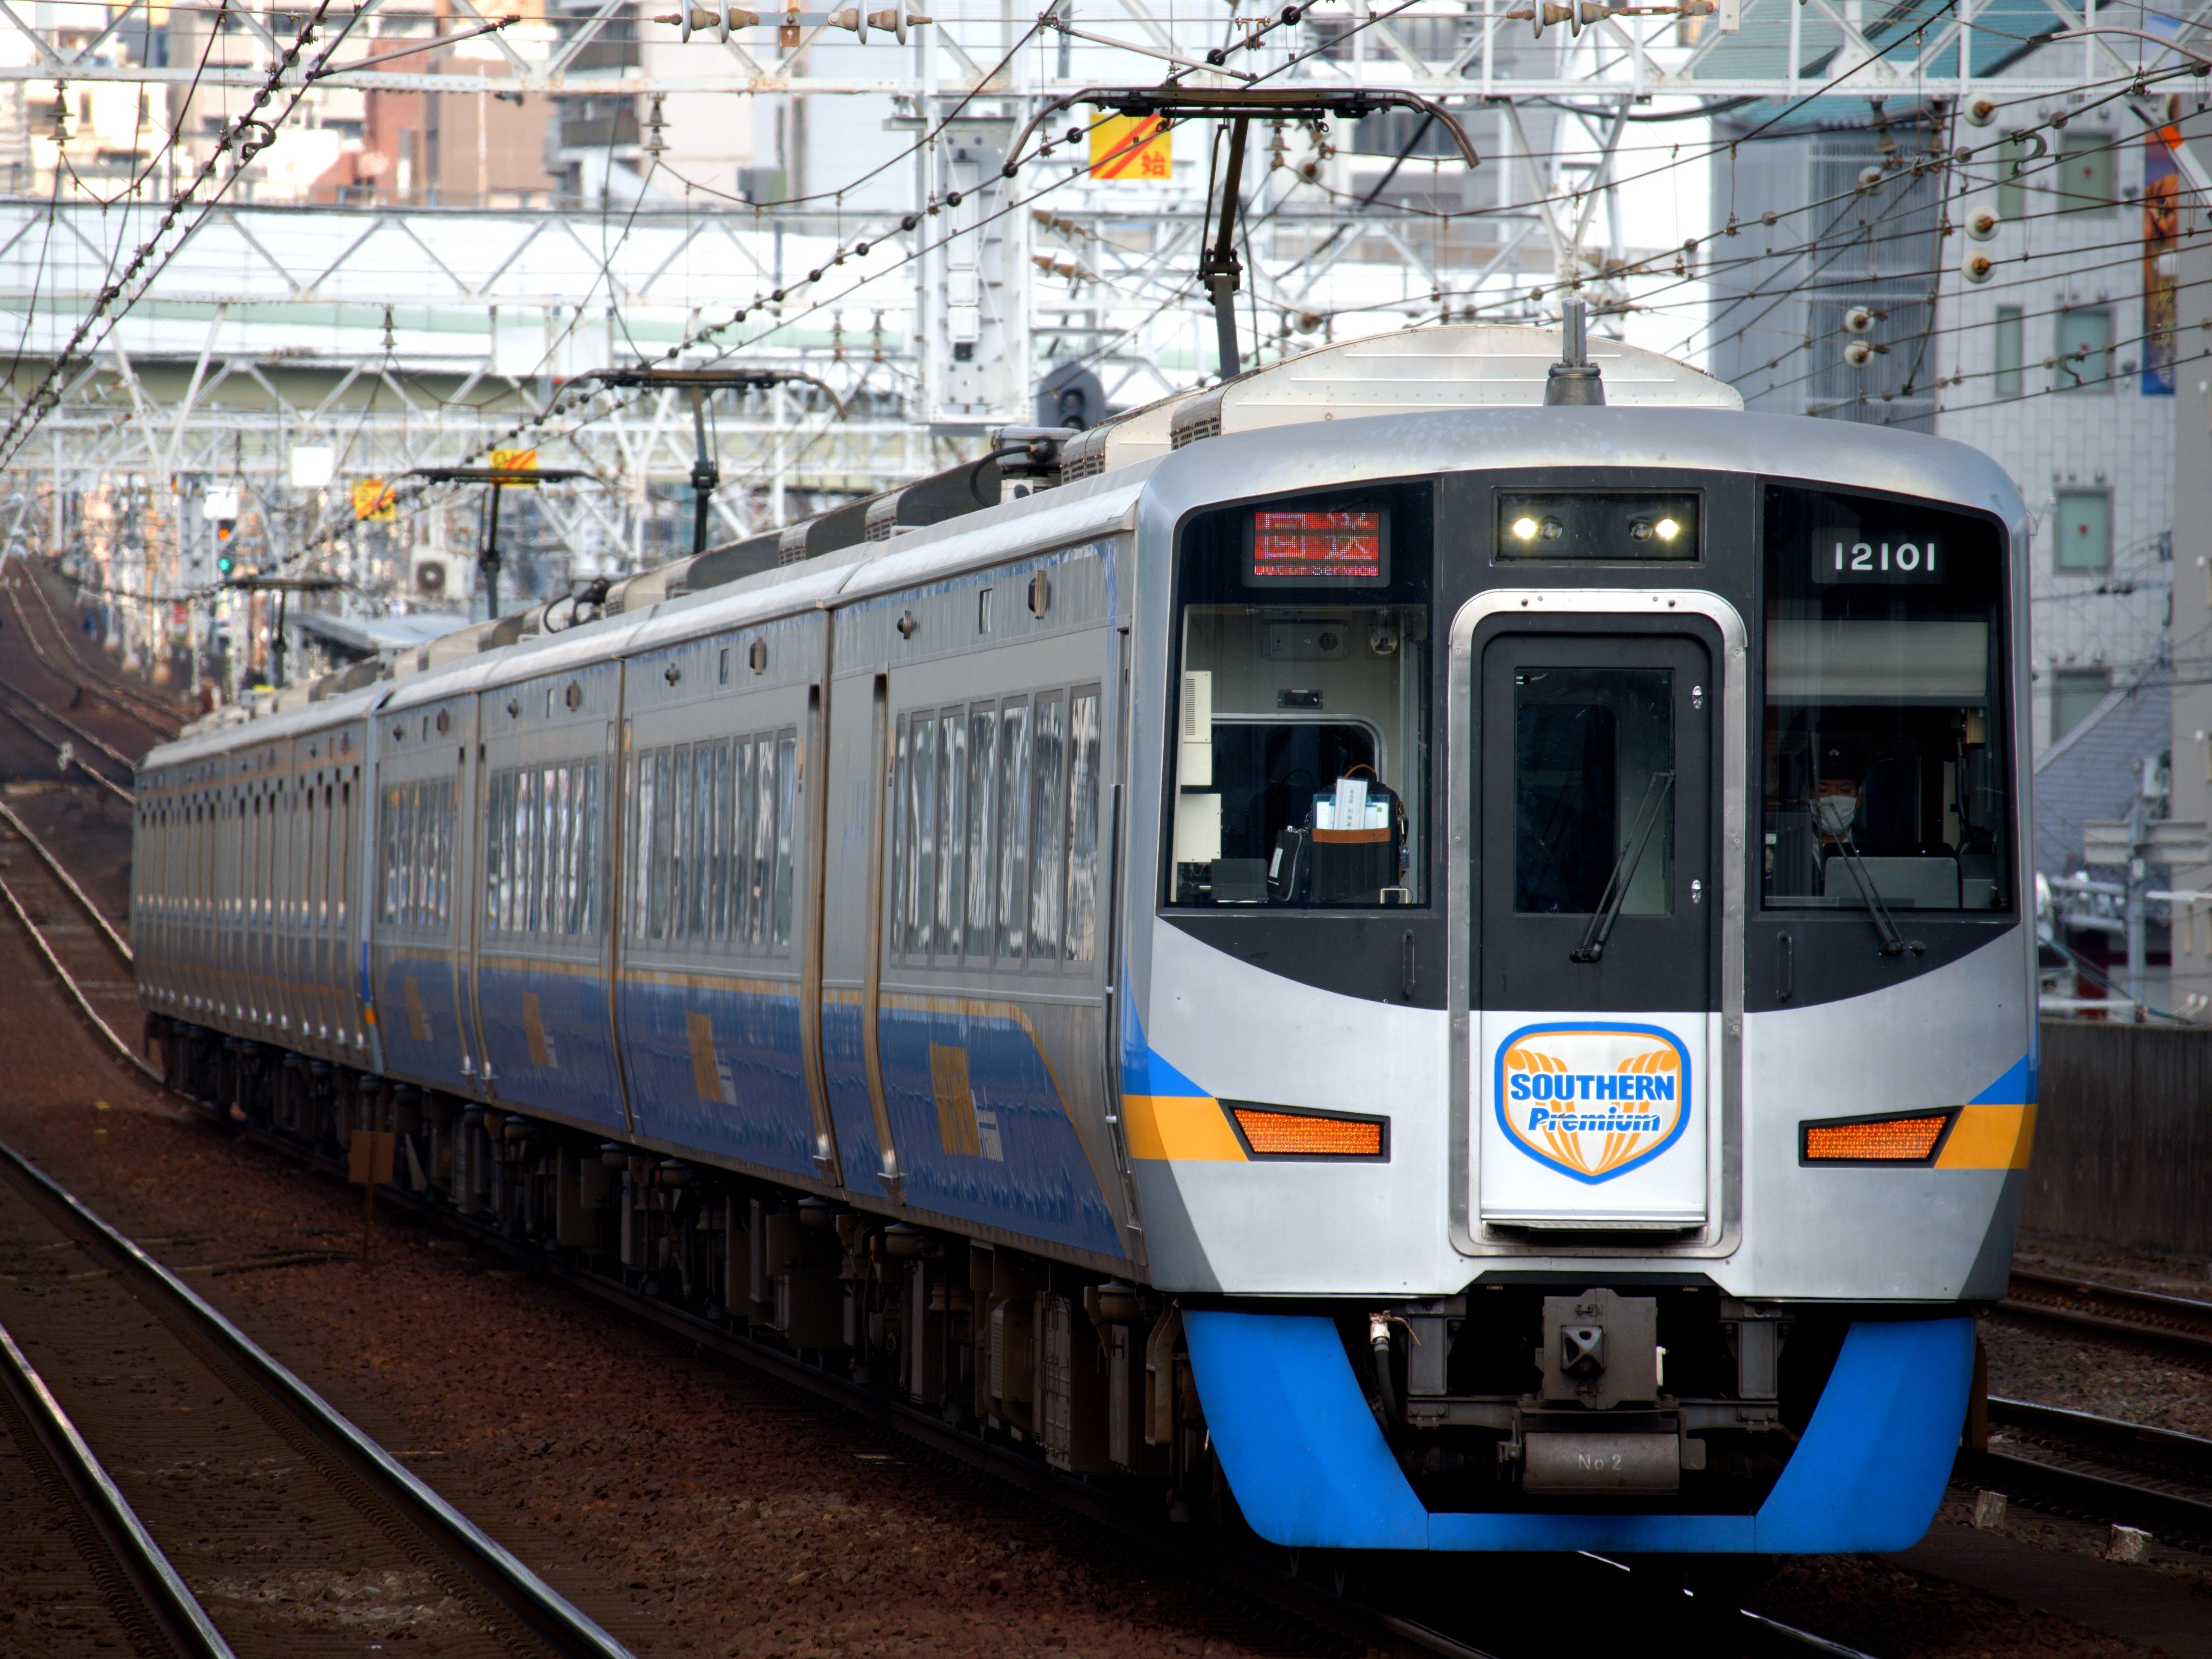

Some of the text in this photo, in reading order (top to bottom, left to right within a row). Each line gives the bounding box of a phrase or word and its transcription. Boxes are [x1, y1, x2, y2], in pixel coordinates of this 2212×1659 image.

[1141, 151, 1166, 176] 始
[1835, 542, 1935, 571] 12101
[1510, 1073, 1675, 1101] SOUTHERN
[1528, 1106, 1661, 1132] Premium
[1578, 1454, 1621, 1470] No 2
